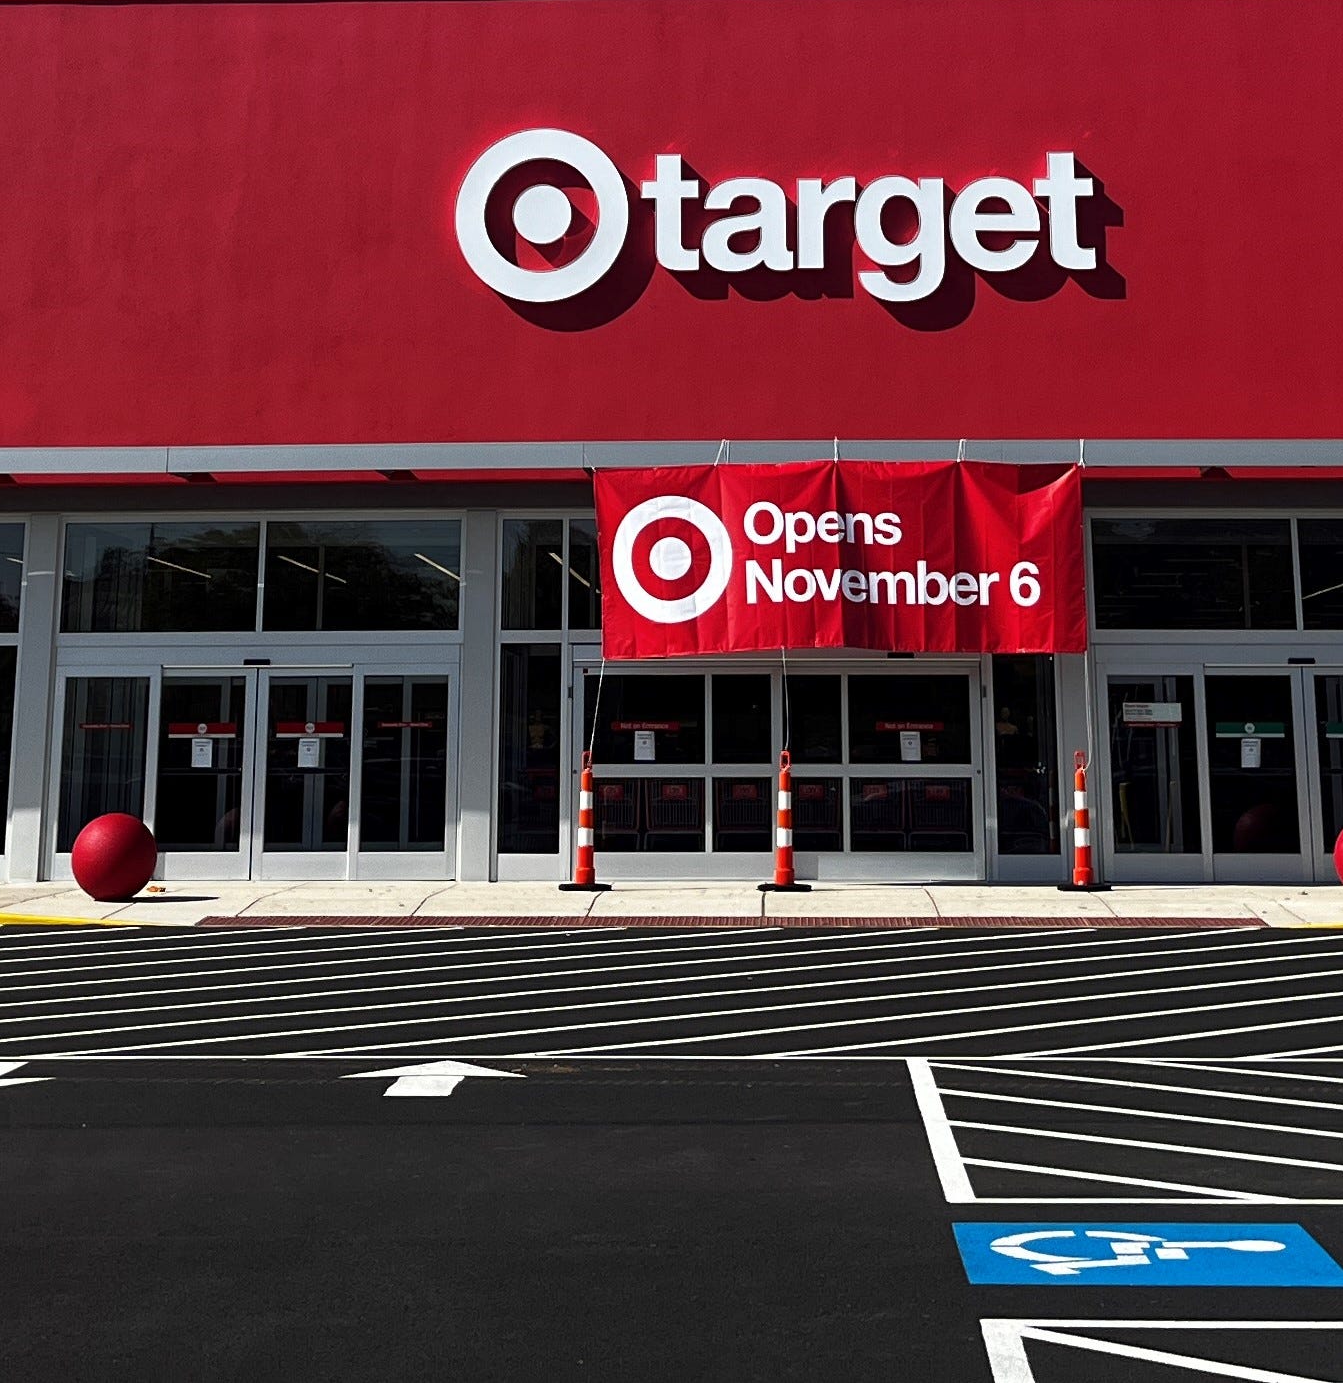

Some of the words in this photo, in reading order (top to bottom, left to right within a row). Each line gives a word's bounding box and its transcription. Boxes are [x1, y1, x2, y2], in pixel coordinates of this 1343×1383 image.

[640, 151, 1098, 303] target
[743, 501, 903, 554] Opens
[744, 559, 1000, 607] November
[1009, 561, 1041, 607] 6
